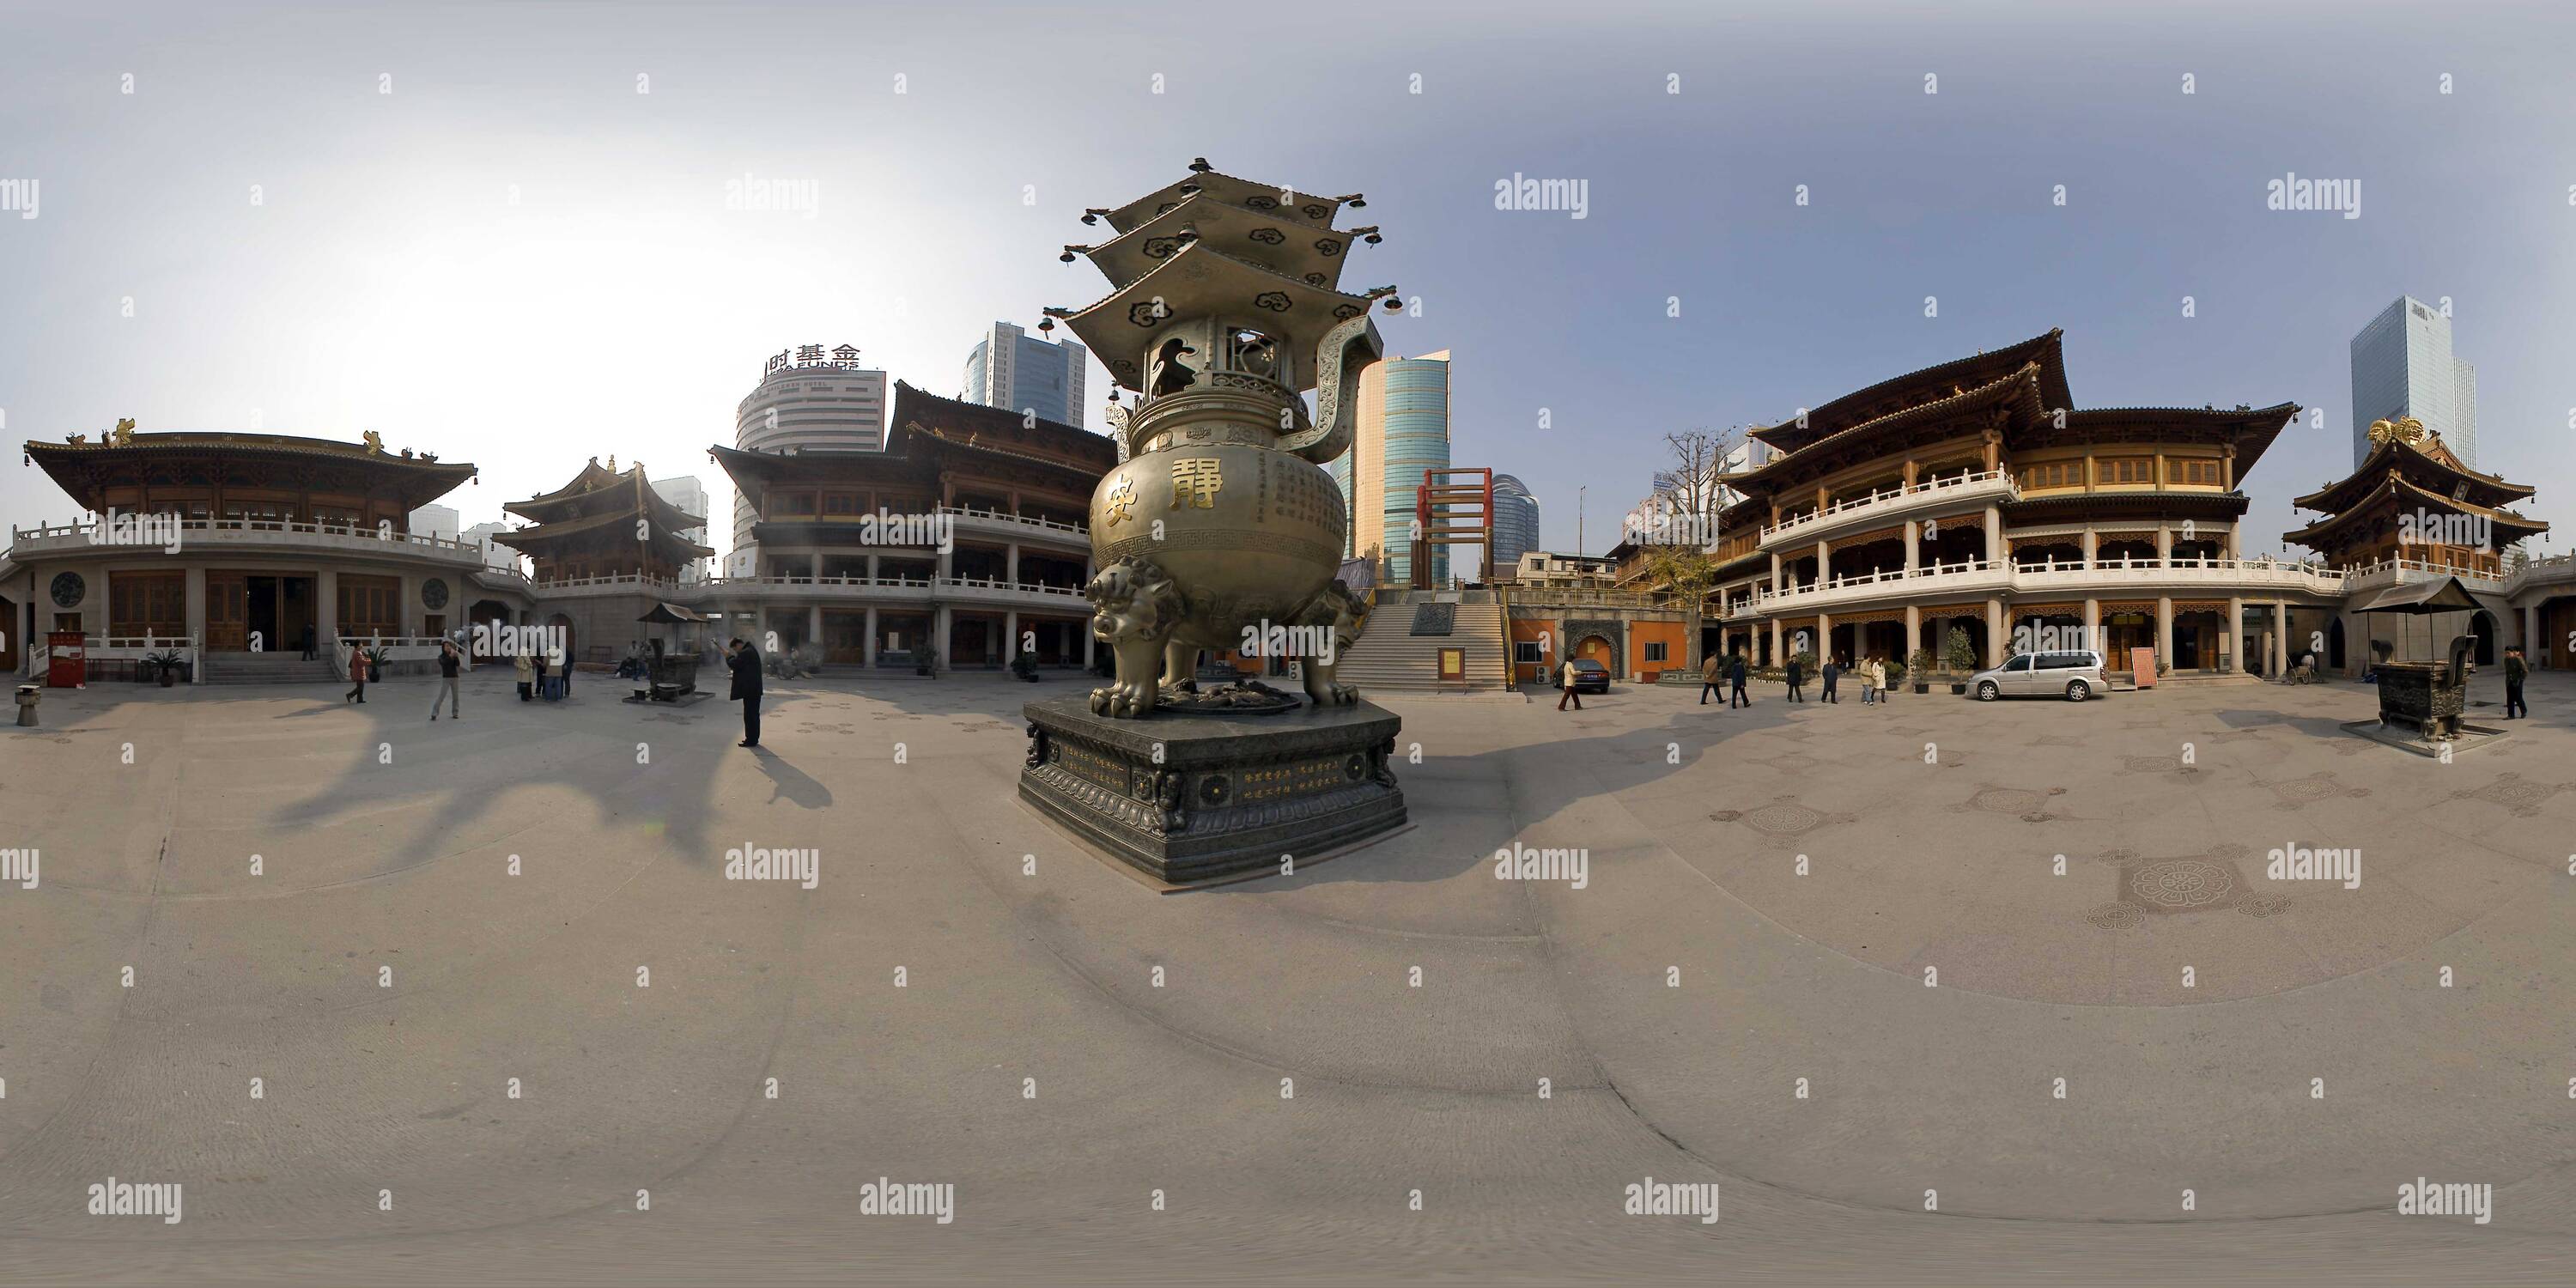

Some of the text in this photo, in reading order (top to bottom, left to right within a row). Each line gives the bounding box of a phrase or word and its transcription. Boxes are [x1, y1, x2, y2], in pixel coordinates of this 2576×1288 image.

[764, 343, 860, 374] 时基金
[797, 361, 859, 369] FUNDS
